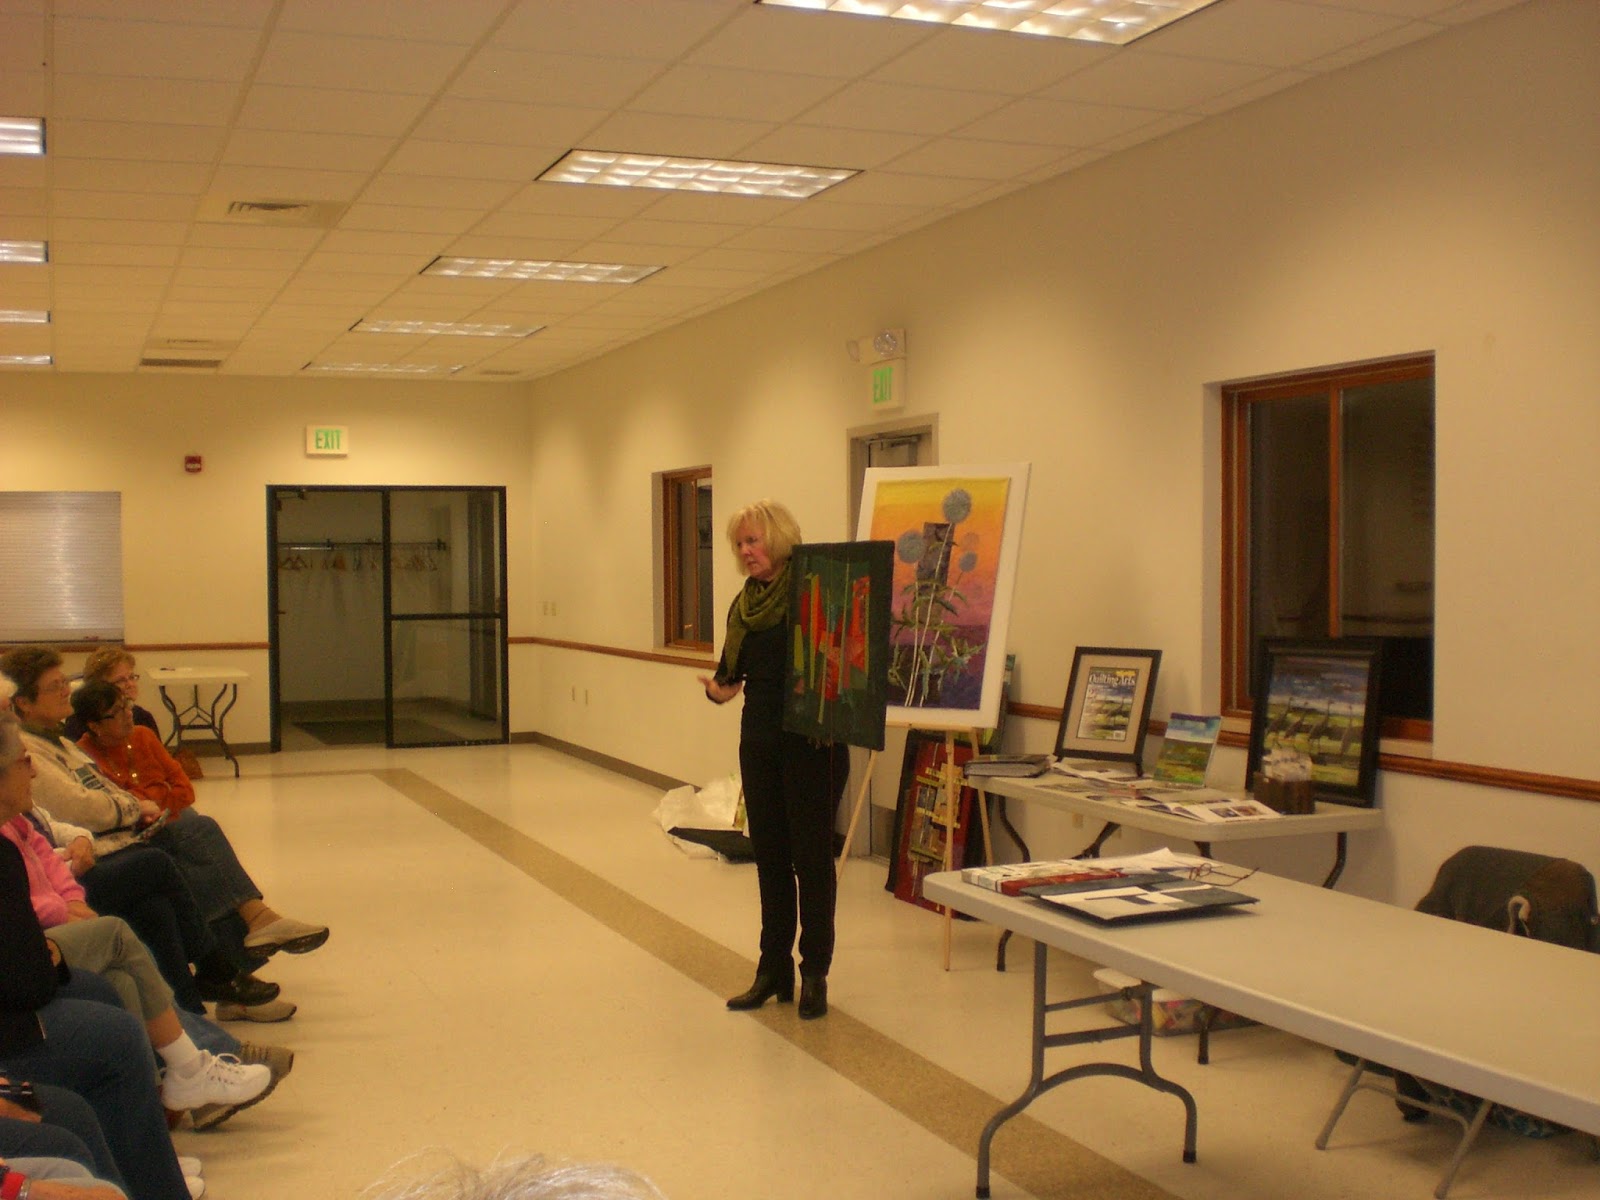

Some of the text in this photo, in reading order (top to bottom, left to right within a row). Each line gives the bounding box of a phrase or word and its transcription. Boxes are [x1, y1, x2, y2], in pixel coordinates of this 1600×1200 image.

[873, 367, 893, 403] EXIT
[315, 430, 342, 450] EXIT
[1089, 673, 1119, 687] Quilting
[1120, 675, 1136, 687] Arts
